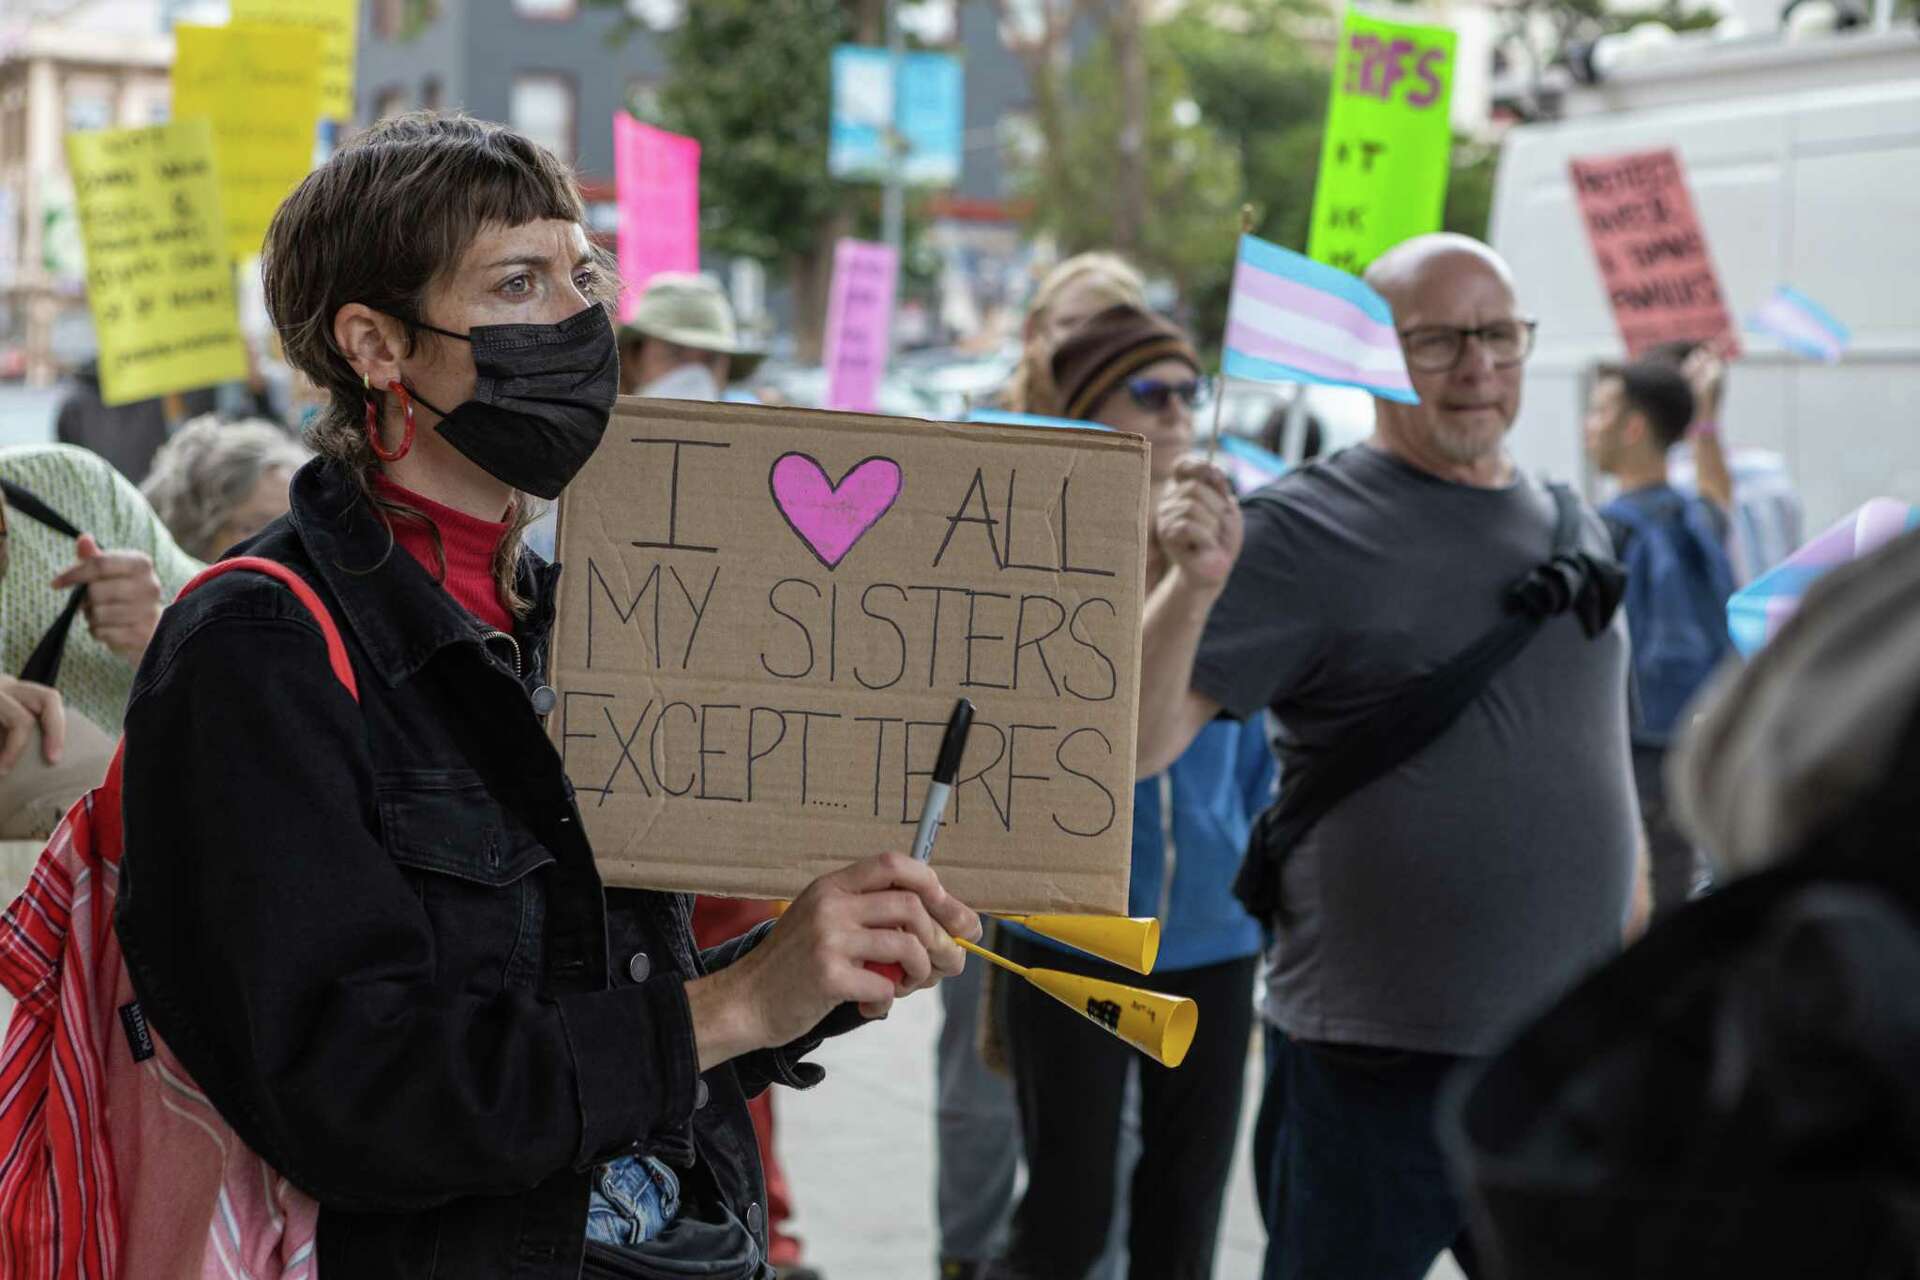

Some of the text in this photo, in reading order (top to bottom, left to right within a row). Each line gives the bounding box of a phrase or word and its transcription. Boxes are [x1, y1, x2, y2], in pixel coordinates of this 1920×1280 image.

[631, 437, 1116, 577] I ALL
[586, 556, 1117, 701] MY SISTERS
[854, 717, 1116, 838] TERFS
